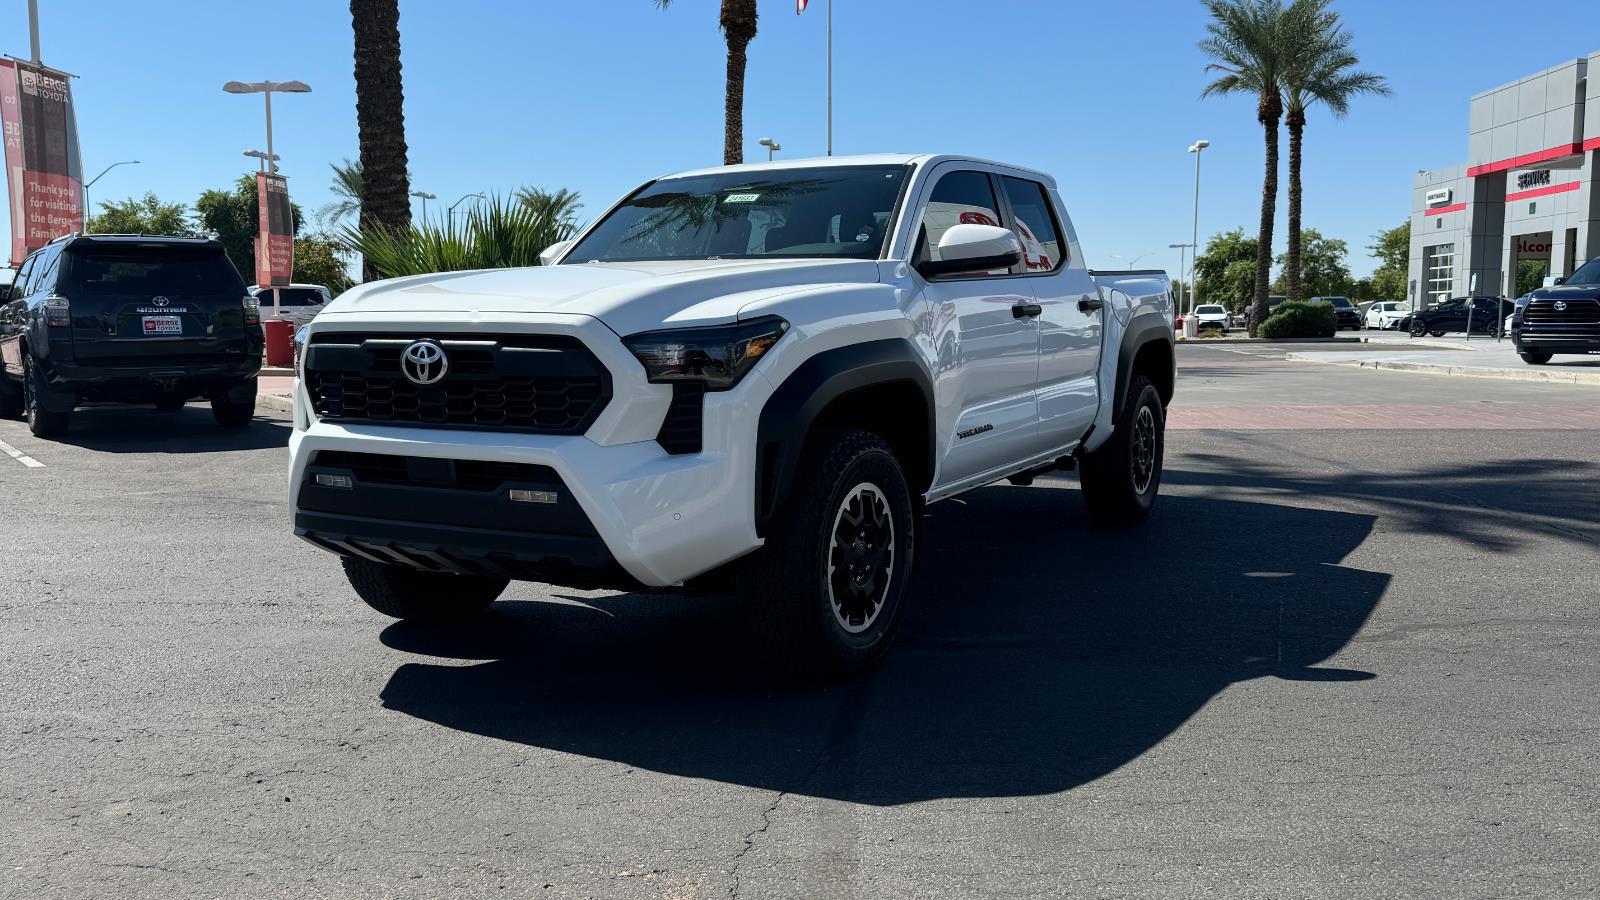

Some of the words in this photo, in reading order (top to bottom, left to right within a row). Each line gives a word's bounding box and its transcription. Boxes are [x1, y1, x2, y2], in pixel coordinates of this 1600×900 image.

[36, 72, 67, 93] BERGE
[38, 88, 69, 104] TOYOTA
[1518, 170, 1550, 188] SERVICE
[29, 182, 57, 195] Thank
[58, 186, 74, 198] you
[30, 197, 44, 208] for
[45, 199, 77, 214] visiting
[30, 212, 46, 223] the
[47, 214, 73, 228] Berge
[31, 227, 62, 239] Family!
